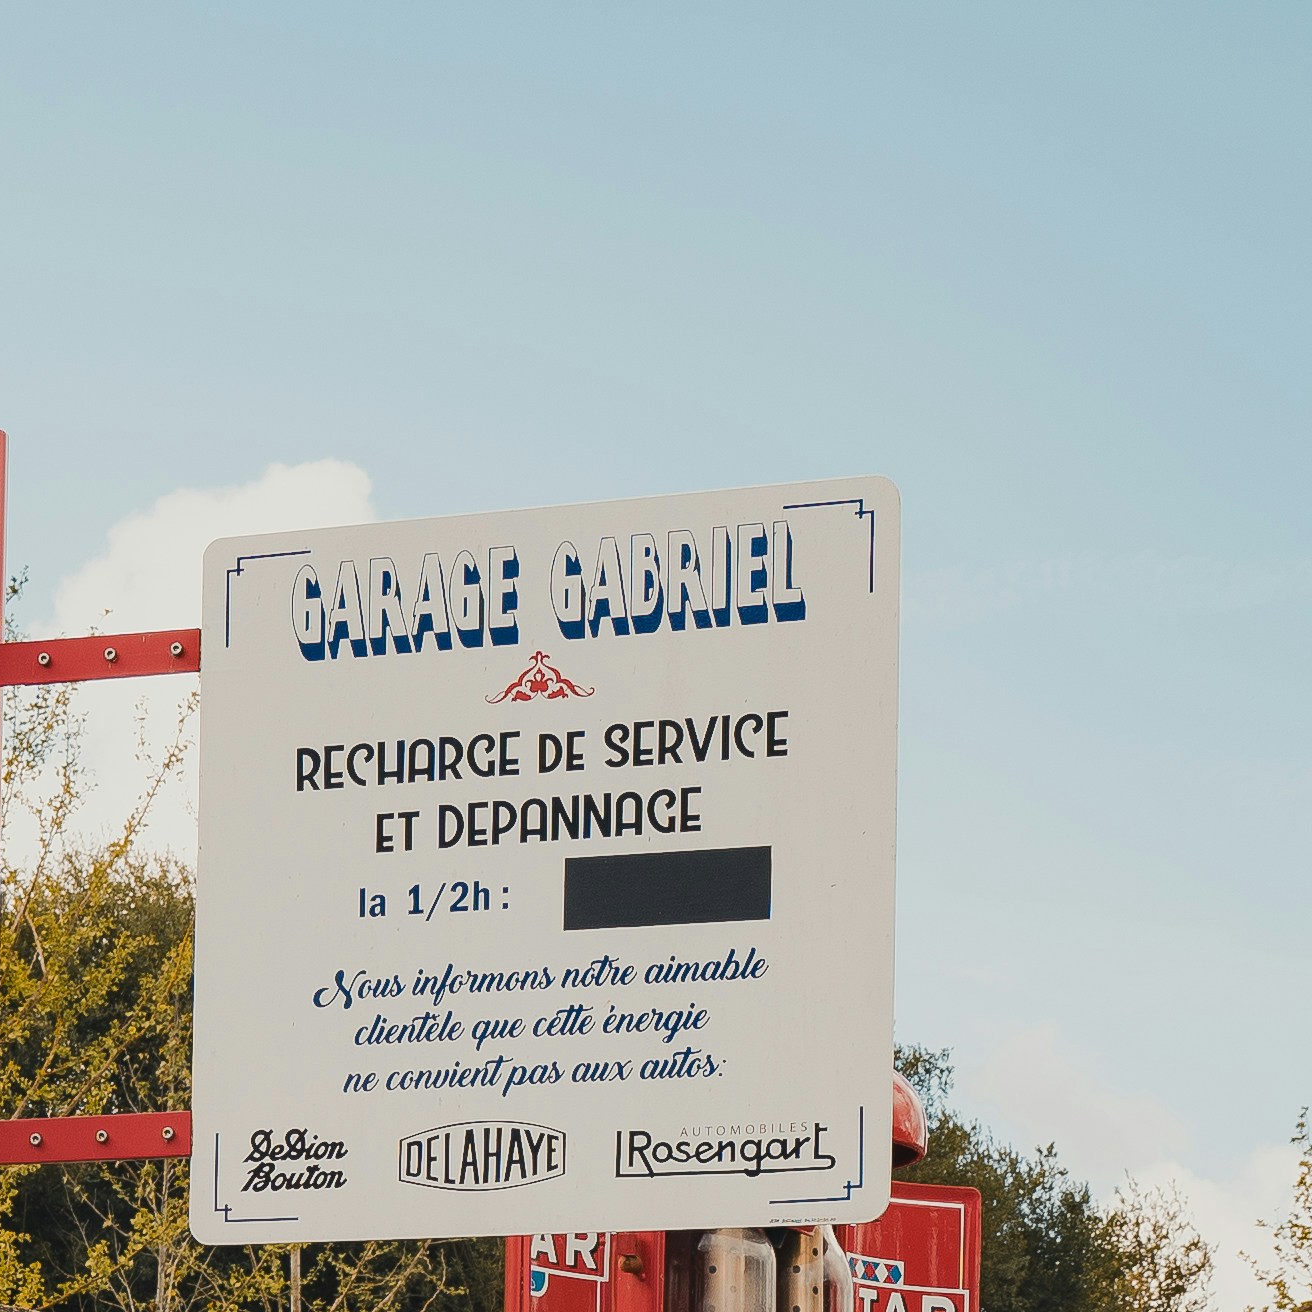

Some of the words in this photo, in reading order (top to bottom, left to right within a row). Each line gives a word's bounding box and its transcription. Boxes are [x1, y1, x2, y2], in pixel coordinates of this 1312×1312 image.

[290, 545, 520, 662] GARAGE
[550, 520, 807, 640] GABRIEL
[297, 731, 520, 791] RECHARGE
[539, 731, 585, 773] DE
[604, 711, 788, 767] SERVICE
[376, 811, 420, 853] ET
[439, 787, 701, 848] DEPANNAGE
[360, 888, 385, 917] la
[313, 970, 405, 1010] Nous
[412, 963, 556, 1006] informons
[644, 947, 769, 984] aimable
[471, 1015, 525, 1051] que
[532, 1004, 596, 1038] cette
[603, 1002, 710, 1043] énergie
[343, 1068, 379, 1093] ne
[386, 1056, 505, 1090] convient
[502, 1056, 565, 1097] pas
[571, 1059, 633, 1083] aux
[680, 1122, 808, 1137] AUTOMOBILES
[241, 1162, 348, 1192] Bouton
[406, 1128, 559, 1184] DELAHAYE
